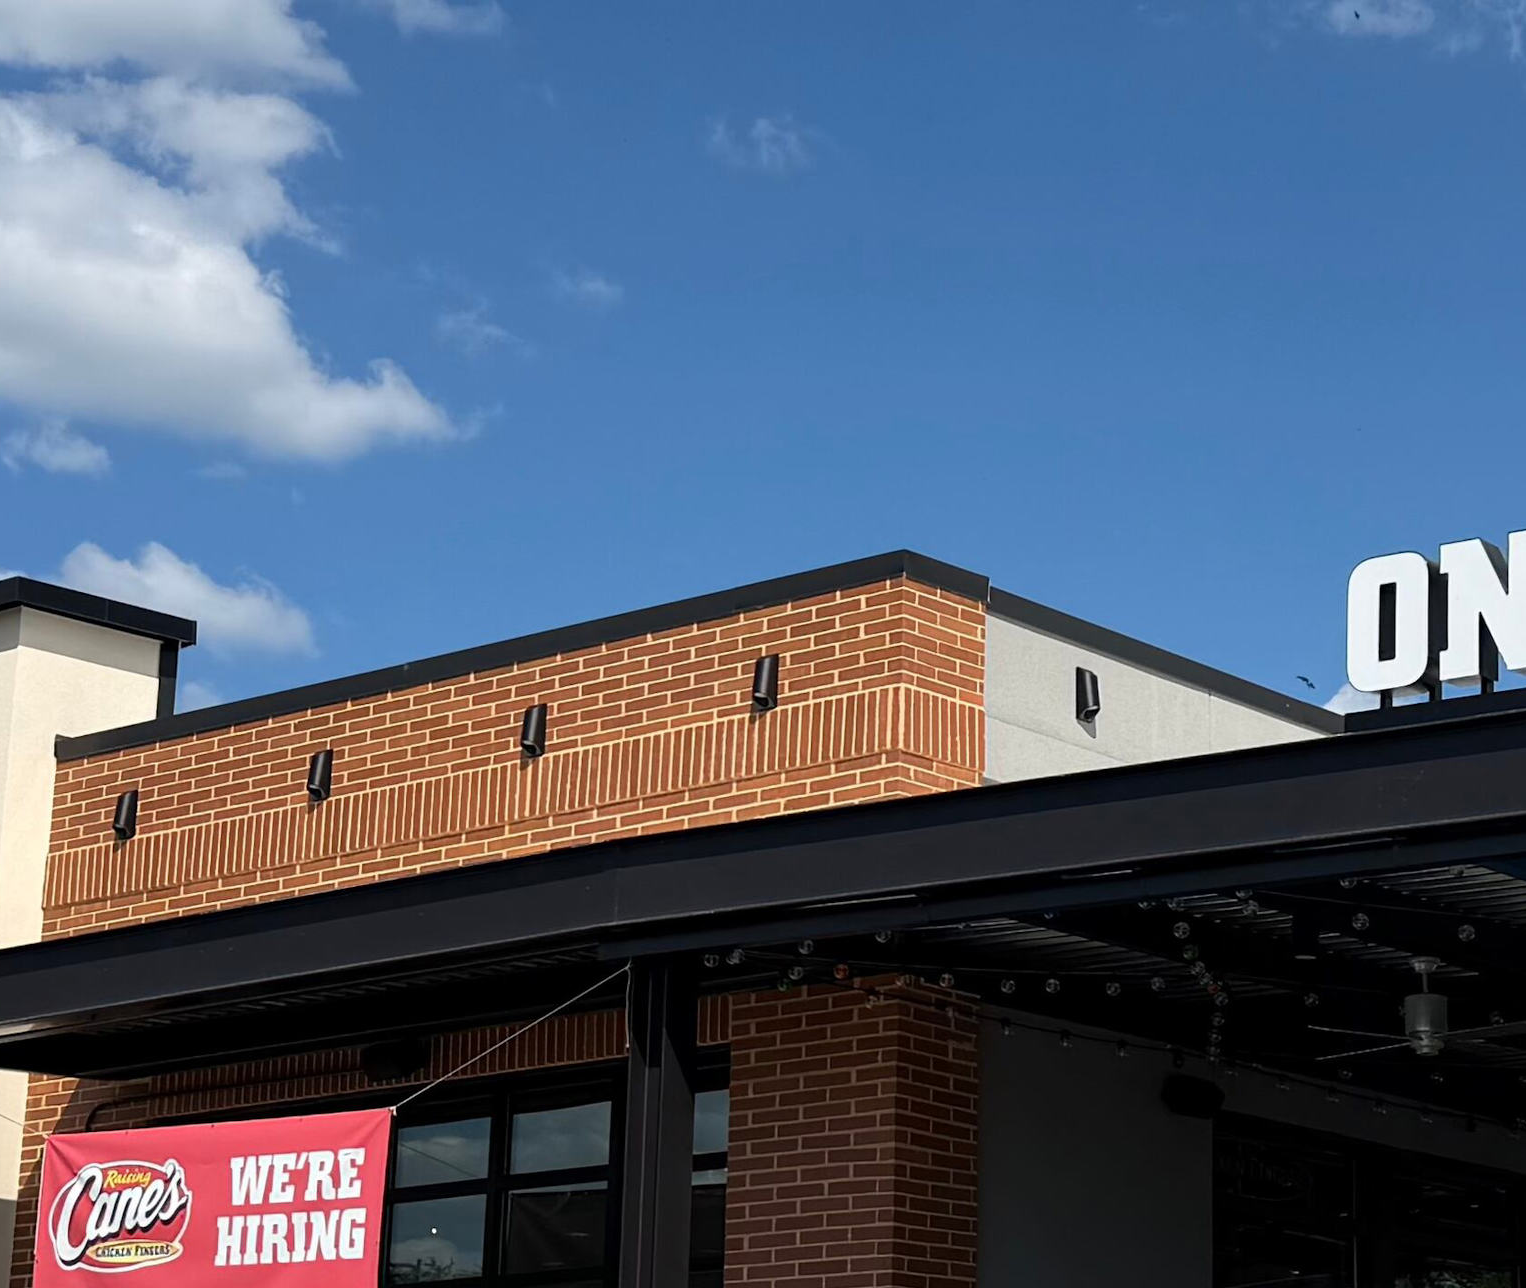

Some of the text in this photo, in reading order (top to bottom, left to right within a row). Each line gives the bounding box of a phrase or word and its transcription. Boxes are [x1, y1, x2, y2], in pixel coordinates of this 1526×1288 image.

[103, 1168, 151, 1188] Raising
[230, 1148, 365, 1206] WE'RE
[56, 1162, 189, 1262] Cane's
[214, 1208, 367, 1266] HIRING
